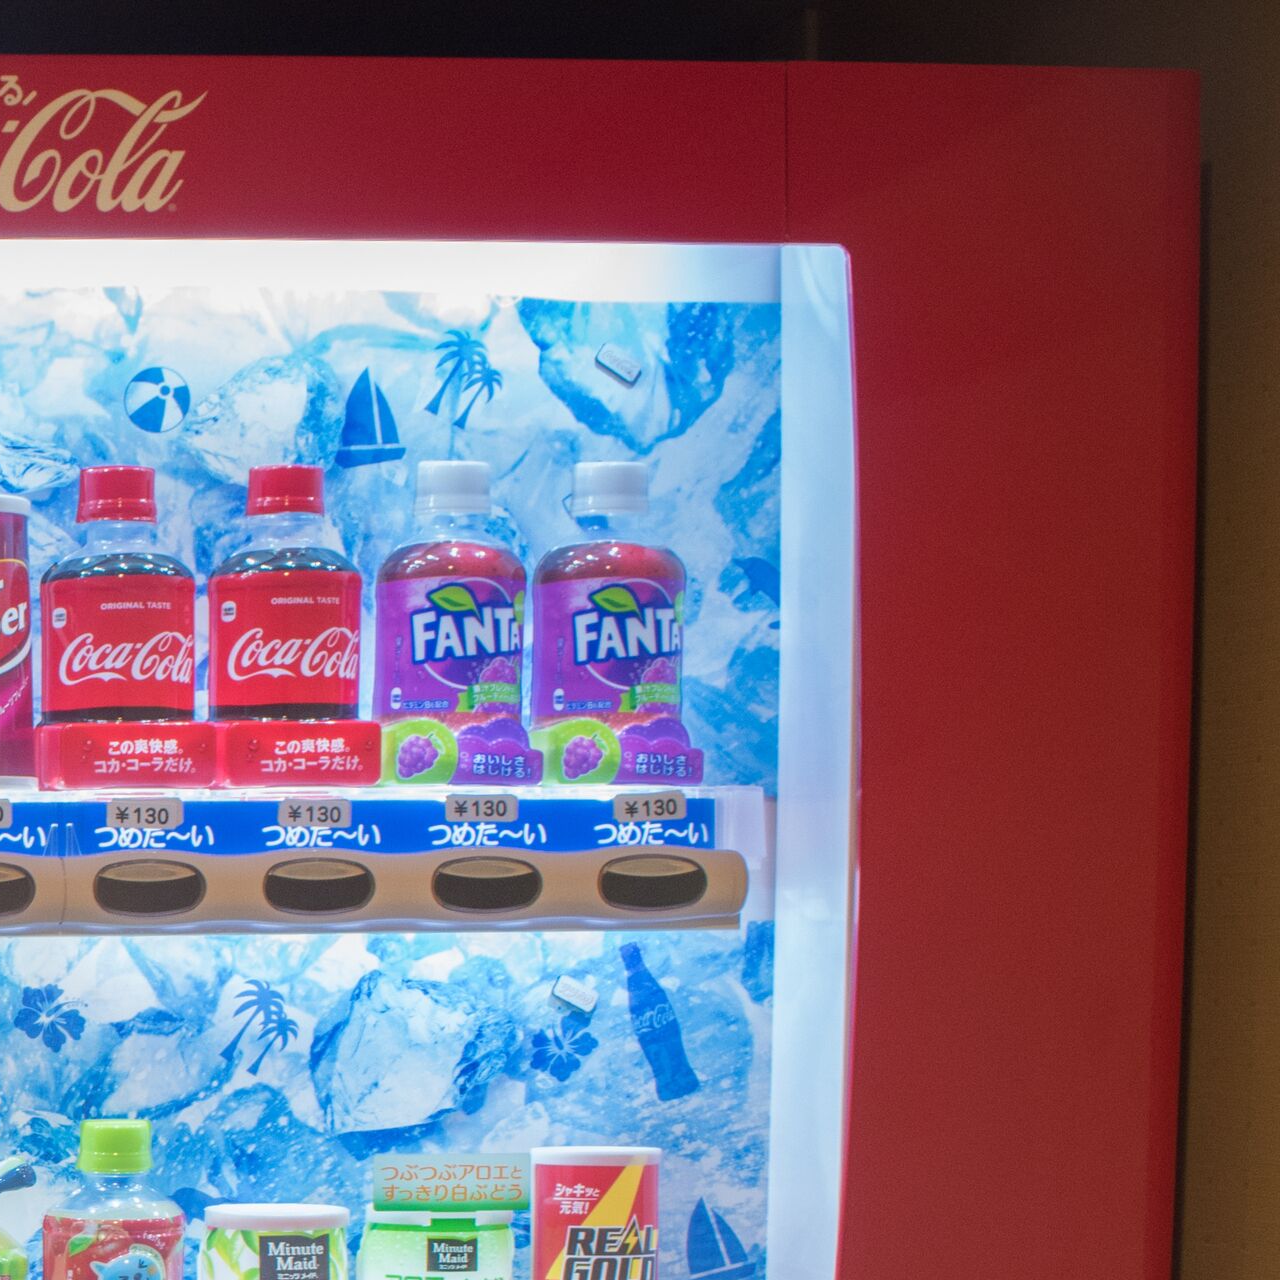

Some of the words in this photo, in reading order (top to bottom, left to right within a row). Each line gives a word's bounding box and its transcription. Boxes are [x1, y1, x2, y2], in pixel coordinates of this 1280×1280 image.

[472, 754, 525, 767] おいしさ
[114, 807, 169, 826] ¥130
[287, 805, 340, 824] ¥130
[624, 798, 678, 817] ¥130
[382, 1164, 522, 1182] つぶつぶアロエと
[382, 1184, 522, 1202] すっきり白ぶどう
[554, 1183, 600, 1198] シャキッと
[559, 1201, 589, 1215] 元気!
[566, 1214, 655, 1255] REAL
[268, 1241, 324, 1258] Minute
[276, 1256, 317, 1271] Maid
